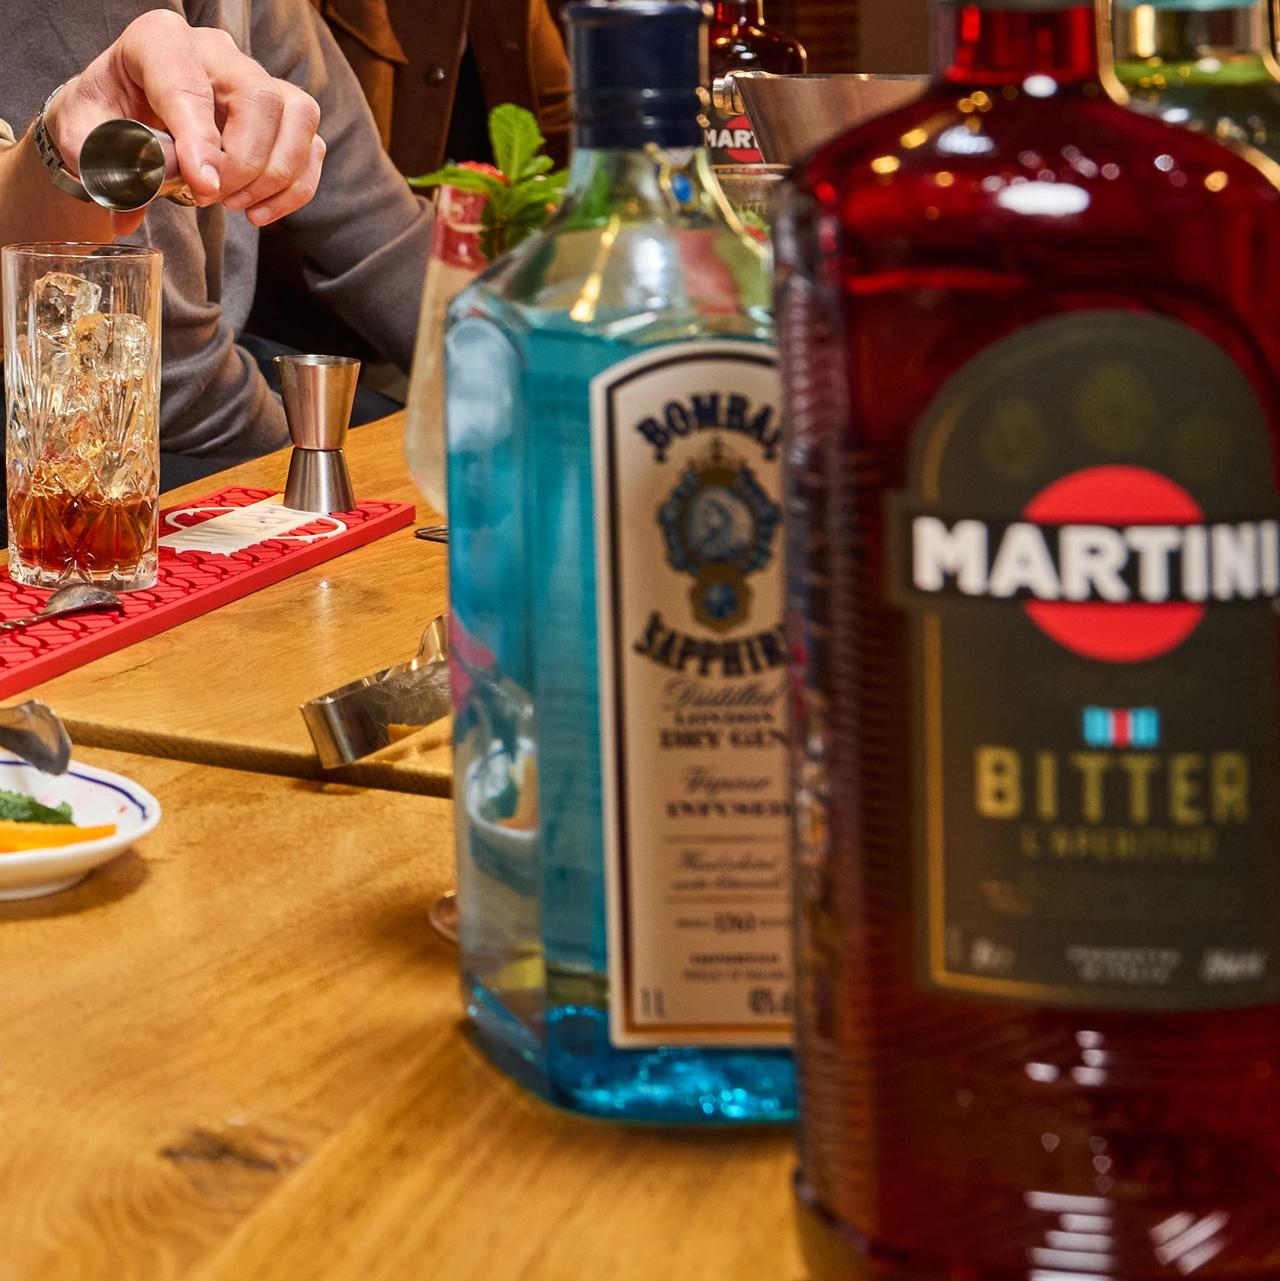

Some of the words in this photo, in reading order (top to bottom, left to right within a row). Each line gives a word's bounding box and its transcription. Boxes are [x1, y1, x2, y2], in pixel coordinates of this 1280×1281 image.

[911, 515, 1280, 602] MARTINI
[660, 728, 721, 748] DRY
[975, 745, 1250, 825] BITTER
